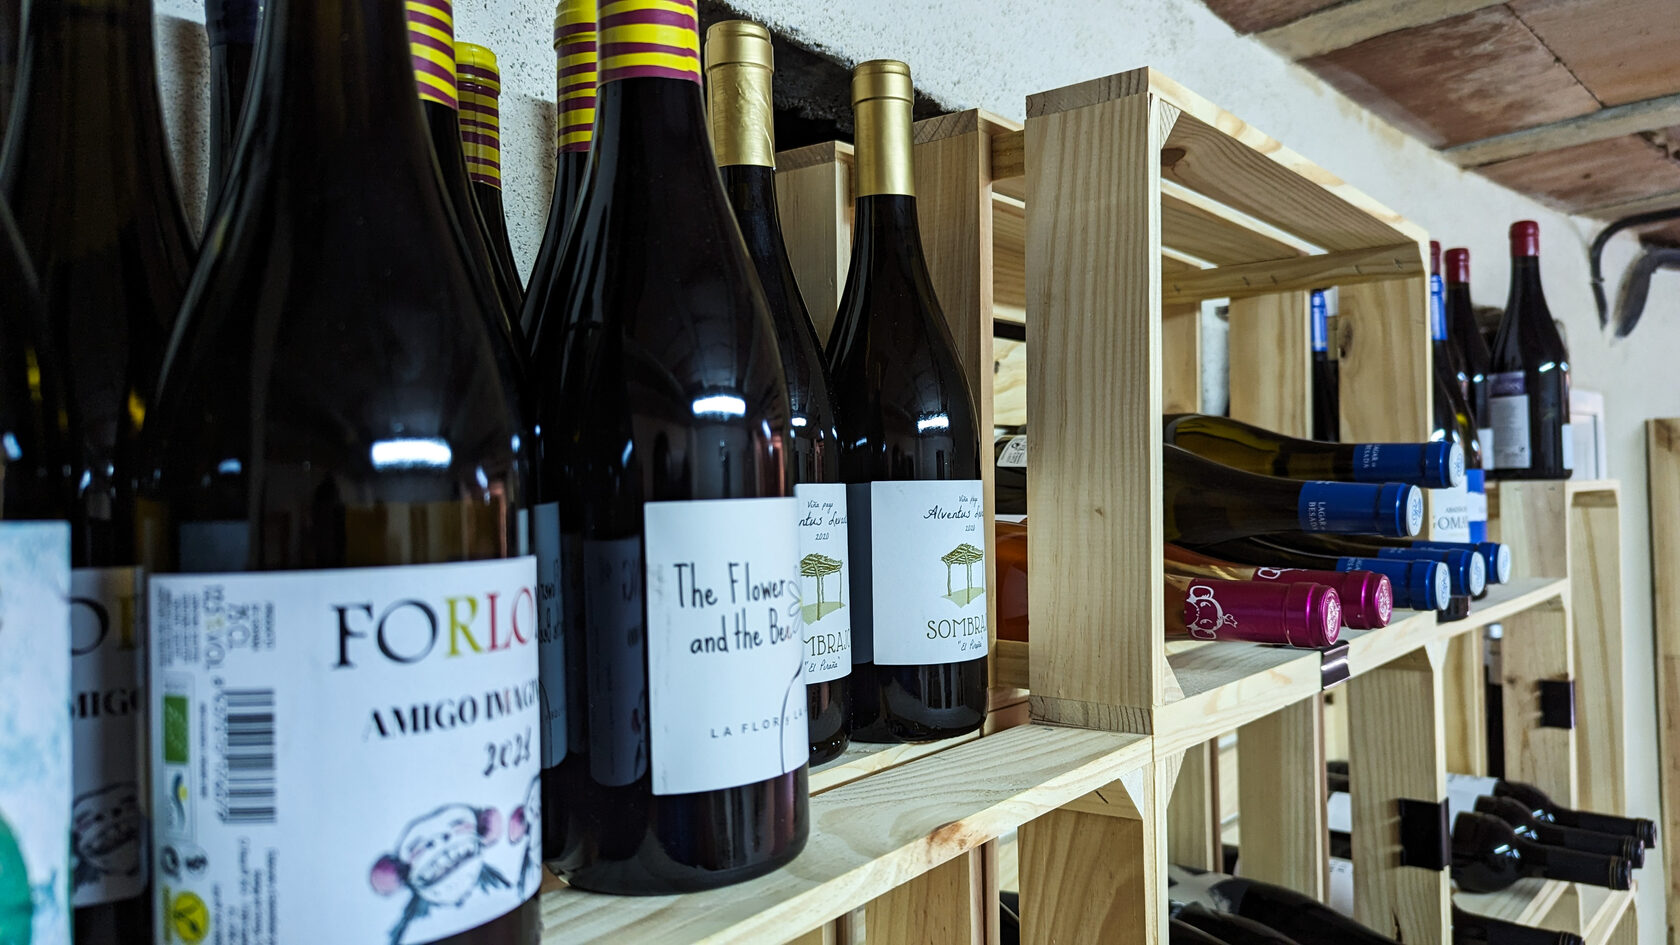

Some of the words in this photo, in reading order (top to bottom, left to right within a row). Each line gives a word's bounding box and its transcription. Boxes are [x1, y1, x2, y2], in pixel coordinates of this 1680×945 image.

[922, 504, 971, 520] Alventus
[1318, 501, 1327, 526] LAGAR
[815, 532, 831, 541] 2020
[673, 561, 718, 609] The
[728, 561, 788, 605] Flower
[333, 589, 536, 669] FORLO
[690, 615, 729, 655] and
[734, 612, 763, 651] the
[768, 607, 795, 648] Bee
[361, 694, 479, 743] AMIGO
[710, 726, 733, 740] LA
[740, 717, 780, 734] FLOR
[481, 724, 534, 778] 2021
